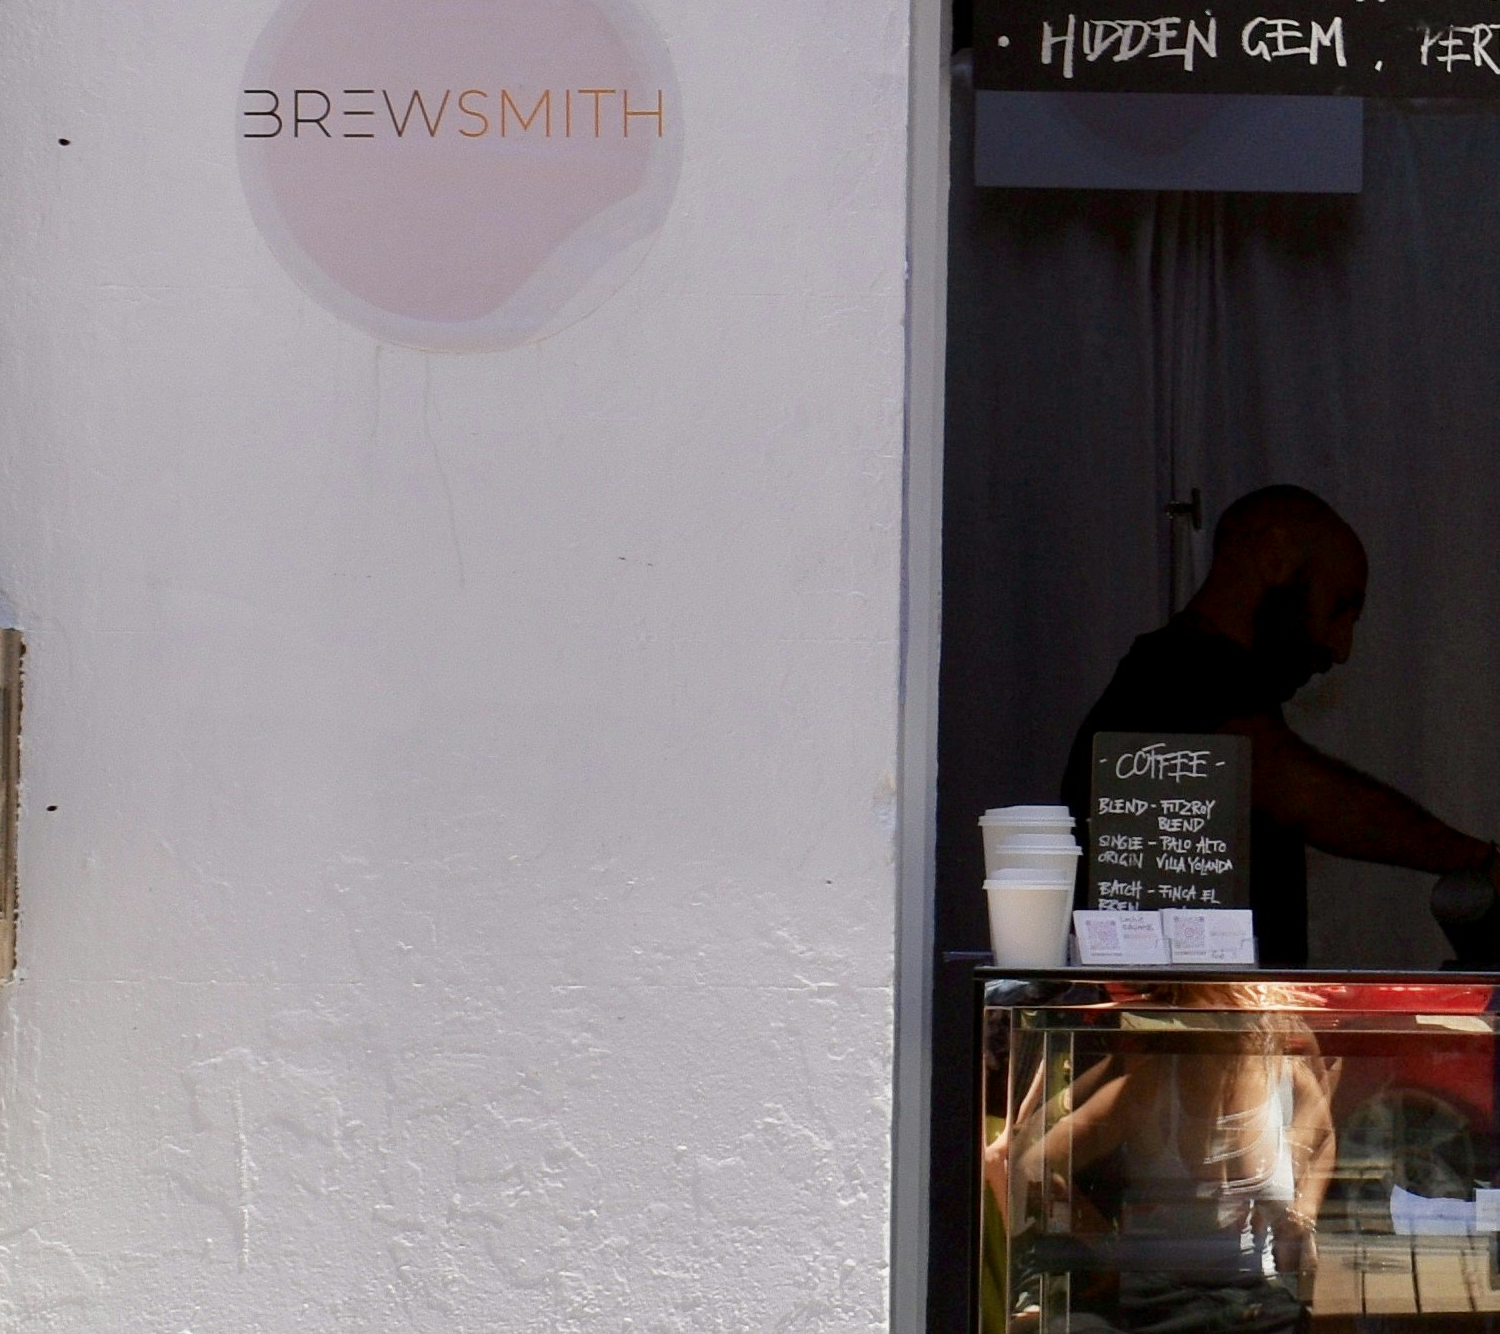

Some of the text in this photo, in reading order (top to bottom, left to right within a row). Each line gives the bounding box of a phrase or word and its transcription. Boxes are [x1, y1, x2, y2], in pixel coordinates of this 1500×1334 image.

[1040, 13, 1218, 80] HIDDEN
[243, 88, 664, 138] BREWSMITH
[1115, 742, 1212, 783] COFFEE
[1098, 797, 1149, 816] BLEND
[1159, 799, 1216, 820] FITZROY
[1157, 816, 1205, 833] BLEND
[1098, 834, 1143, 850] SINGLE
[1158, 835, 1192, 853] PALO
[1196, 835, 1227, 855] ALTO
[1187, 856, 1234, 876] YOLANDA
[1097, 879, 1143, 899] BATCH
